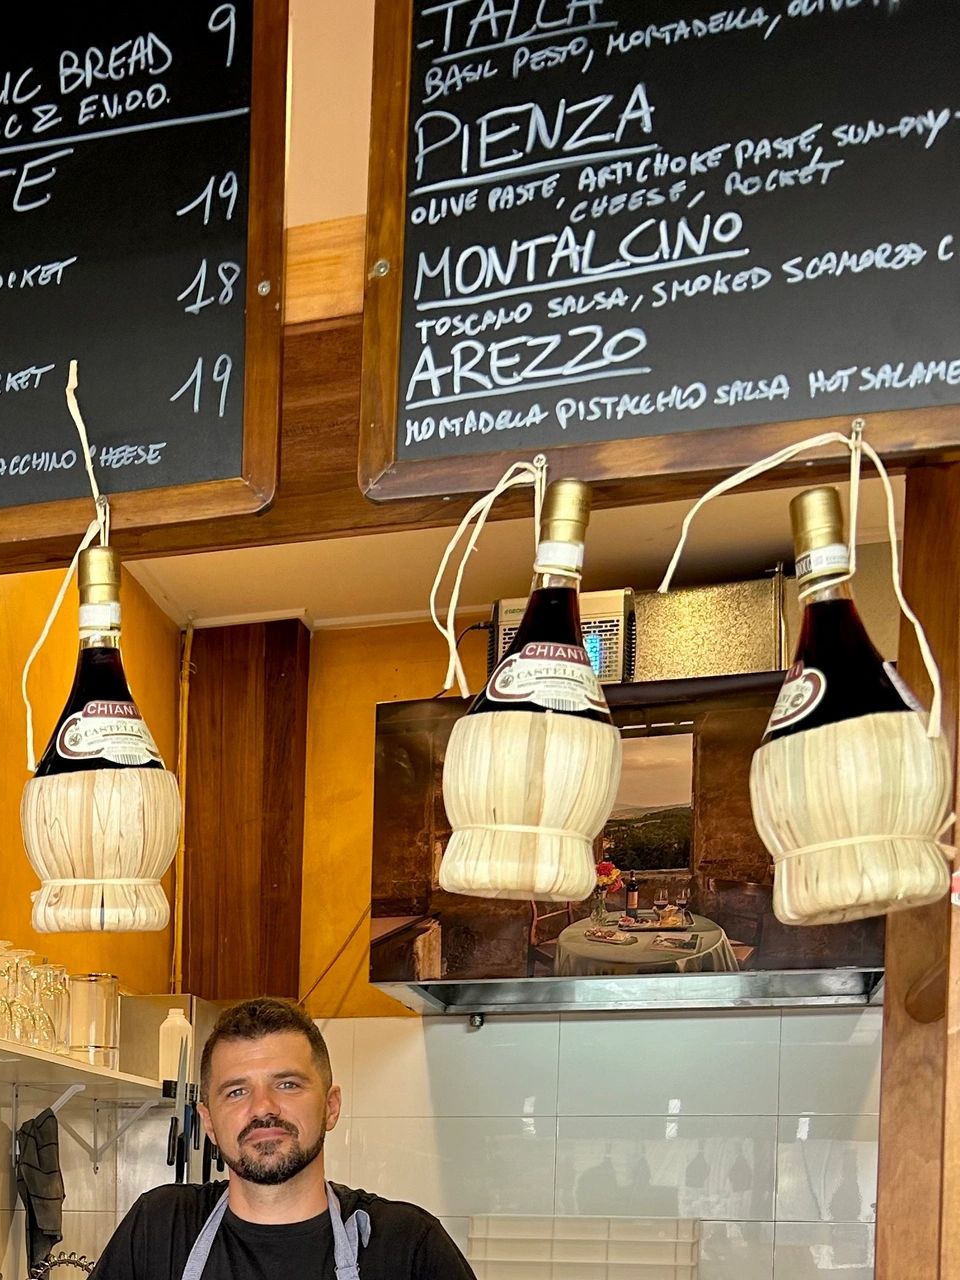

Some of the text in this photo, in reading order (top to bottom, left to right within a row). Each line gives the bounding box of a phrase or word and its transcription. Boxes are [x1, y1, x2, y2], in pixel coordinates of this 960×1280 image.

[59, 32, 172, 94] BREAD
[208, 3, 236, 67] 9
[422, 60, 498, 104] BASIL
[512, 36, 594, 79] PESTO,
[606, 7, 782, 56] MORTADELLA,
[414, 82, 656, 181] PIENZA
[176, 170, 238, 226] 19
[410, 189, 478, 225] OLIVE
[578, 143, 731, 192] ARTICHOKE
[570, 158, 845, 223] CHEESE, ROCKET
[176, 258, 241, 314] 18
[413, 211, 744, 300] MONTALCINO
[415, 301, 533, 344] TOSCANO
[651, 266, 772, 308] SMOKED
[169, 352, 233, 418] 19
[405, 324, 648, 402] AREZZO
[405, 358, 960, 446] MORTADELLA PISTACCHIO SALSA HOT SALAME
